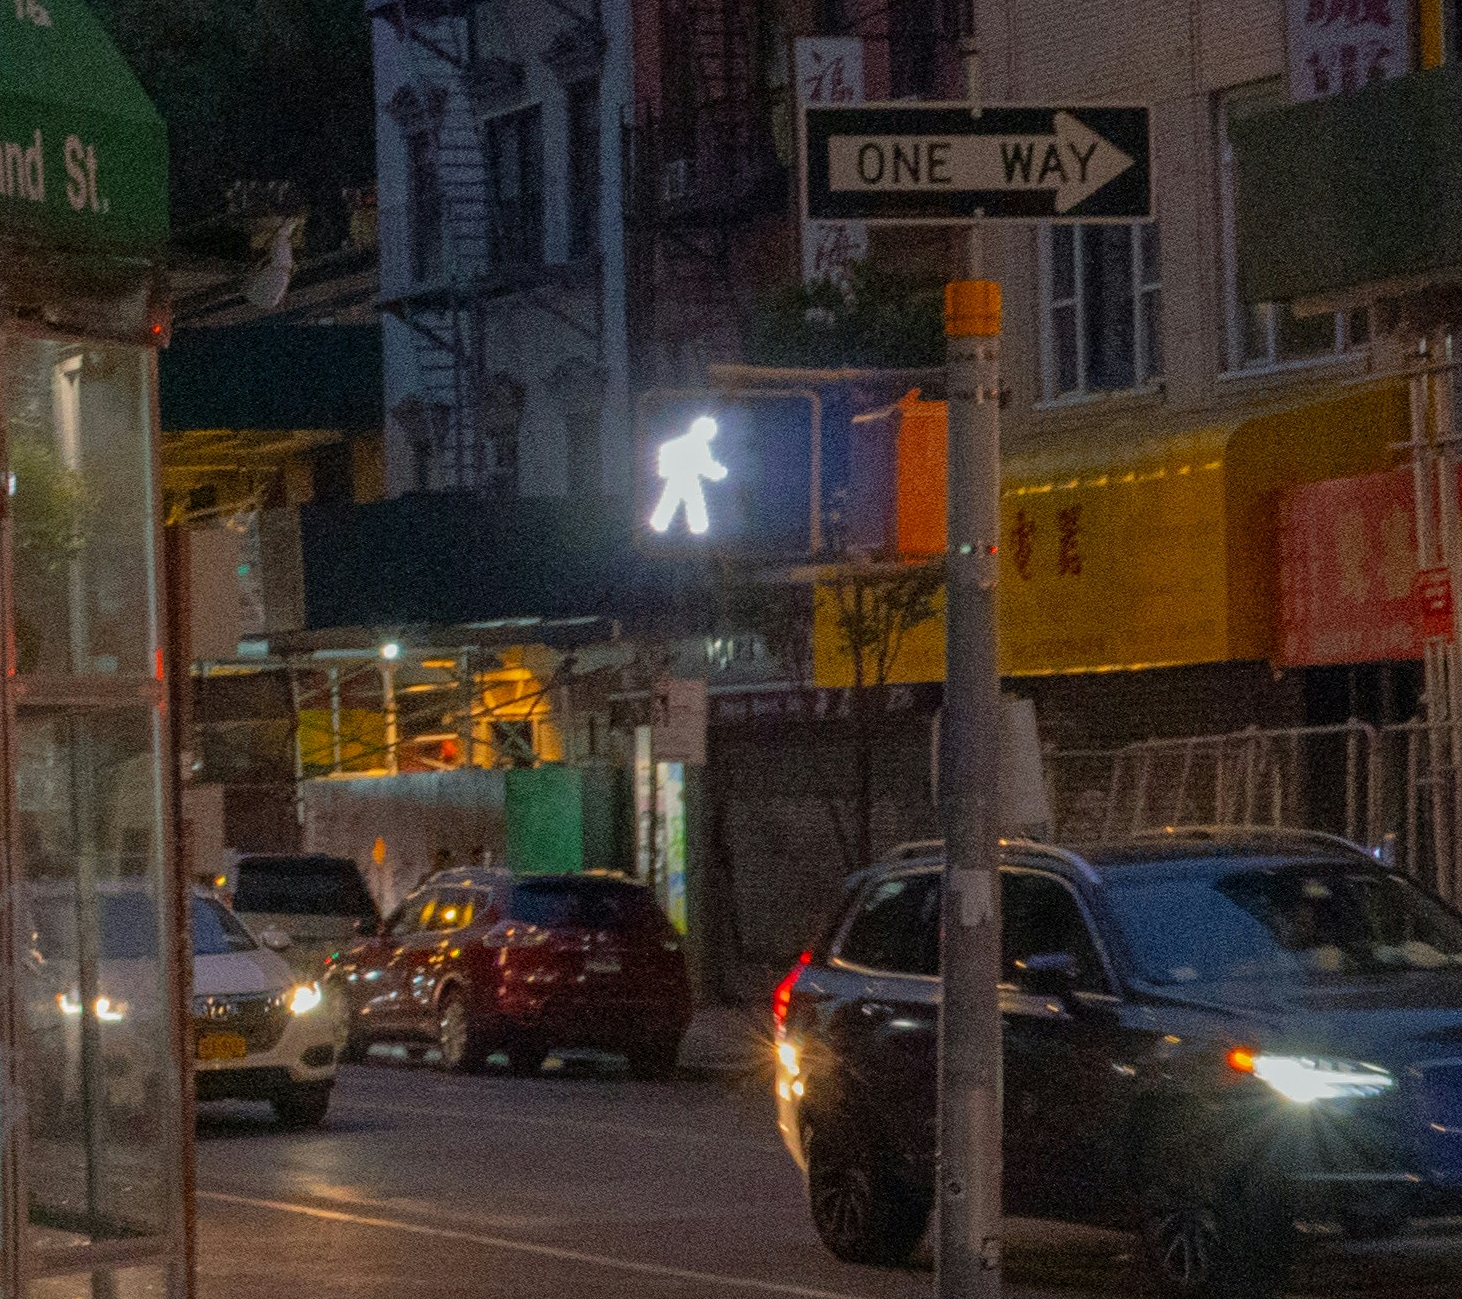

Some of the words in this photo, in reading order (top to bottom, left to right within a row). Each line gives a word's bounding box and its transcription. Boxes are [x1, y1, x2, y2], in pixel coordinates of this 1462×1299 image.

[62, 133, 111, 214] St.
[856, 142, 954, 186] ONE
[999, 142, 1100, 186] WAY
